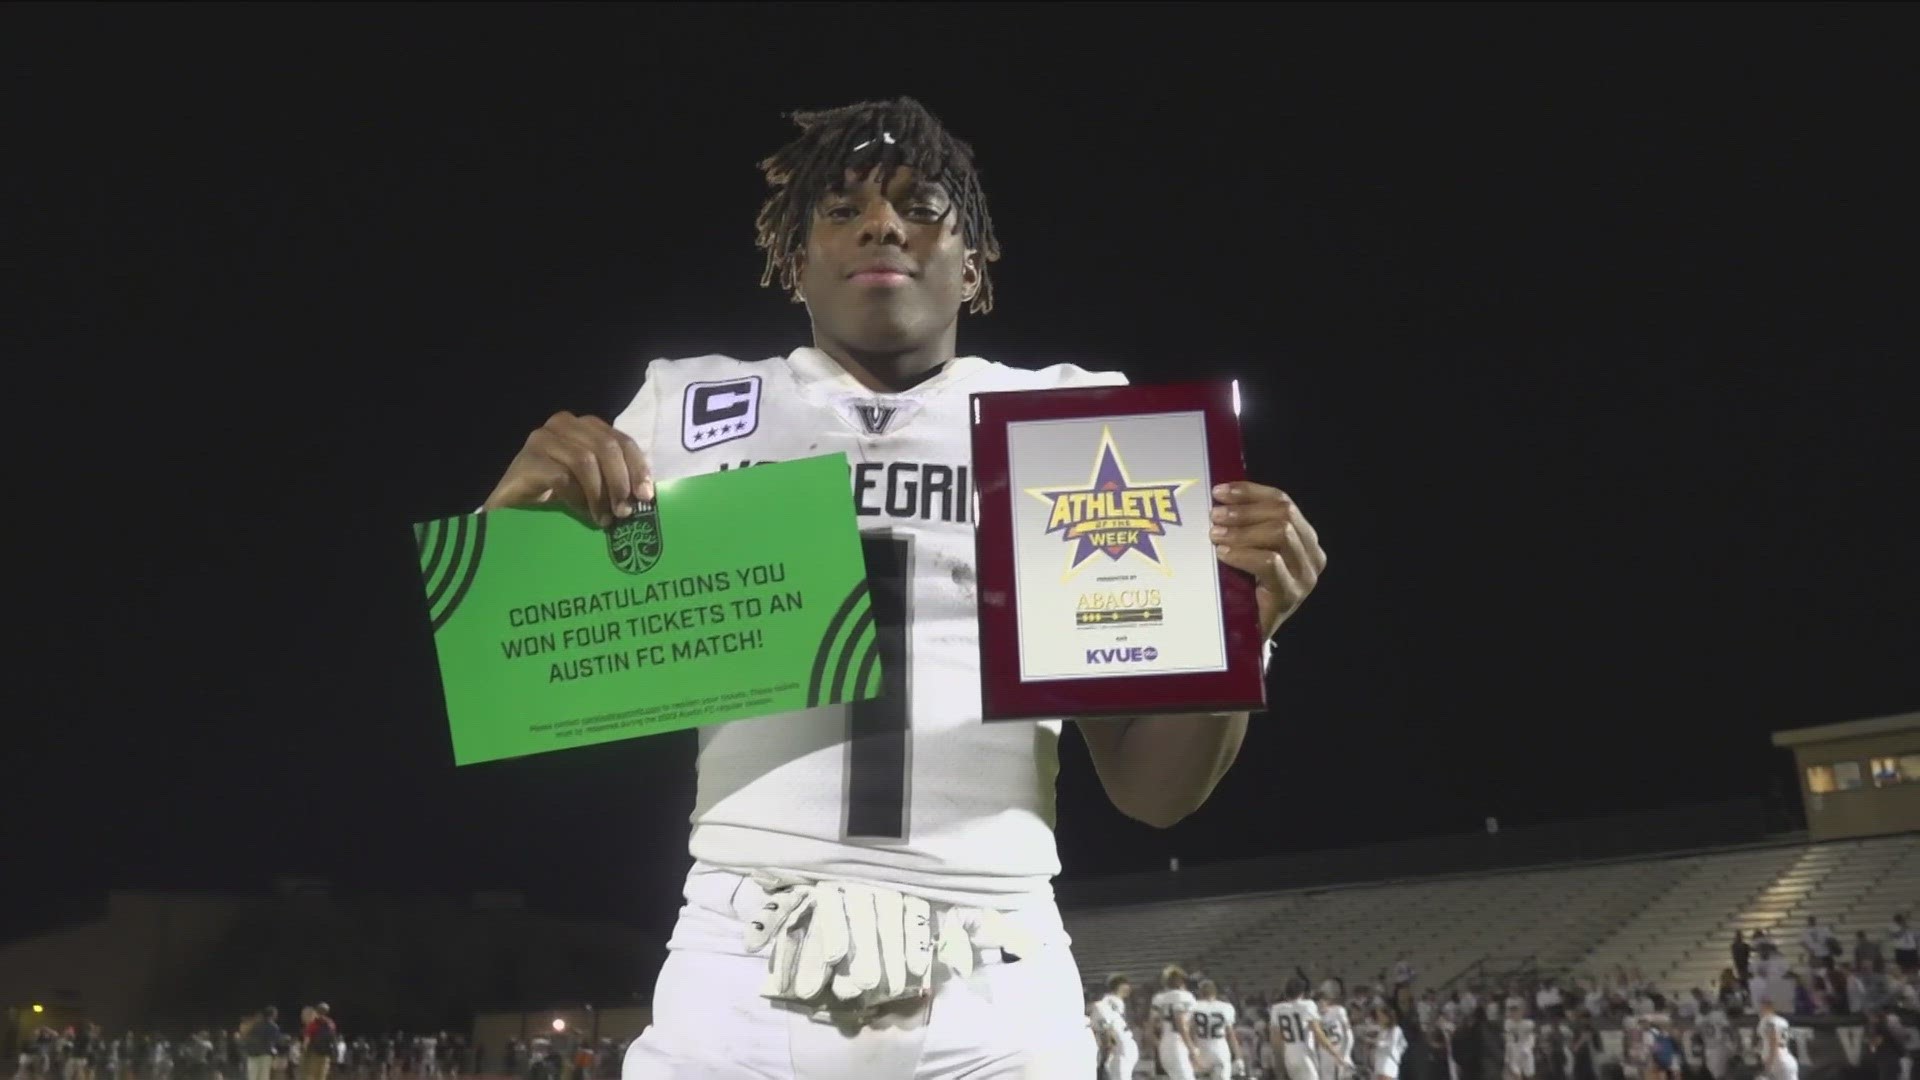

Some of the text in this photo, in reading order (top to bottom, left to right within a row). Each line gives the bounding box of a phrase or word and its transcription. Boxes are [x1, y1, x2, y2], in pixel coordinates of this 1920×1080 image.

[693, 381, 751, 427] C
[1049, 488, 1178, 529] ATHLETE
[1112, 519, 1132, 527] THE
[1088, 530, 1139, 547] WEEK
[509, 563, 785, 628] CONGRATULATIONS YOU
[1077, 589, 1161, 609] ABACUS
[501, 591, 803, 660] WON FOUR TICKETS TO AN
[549, 629, 763, 683] AUSTIN FC MATCH!
[1086, 647, 1142, 664] KVUE
[1278, 1012, 1305, 1043] 81
